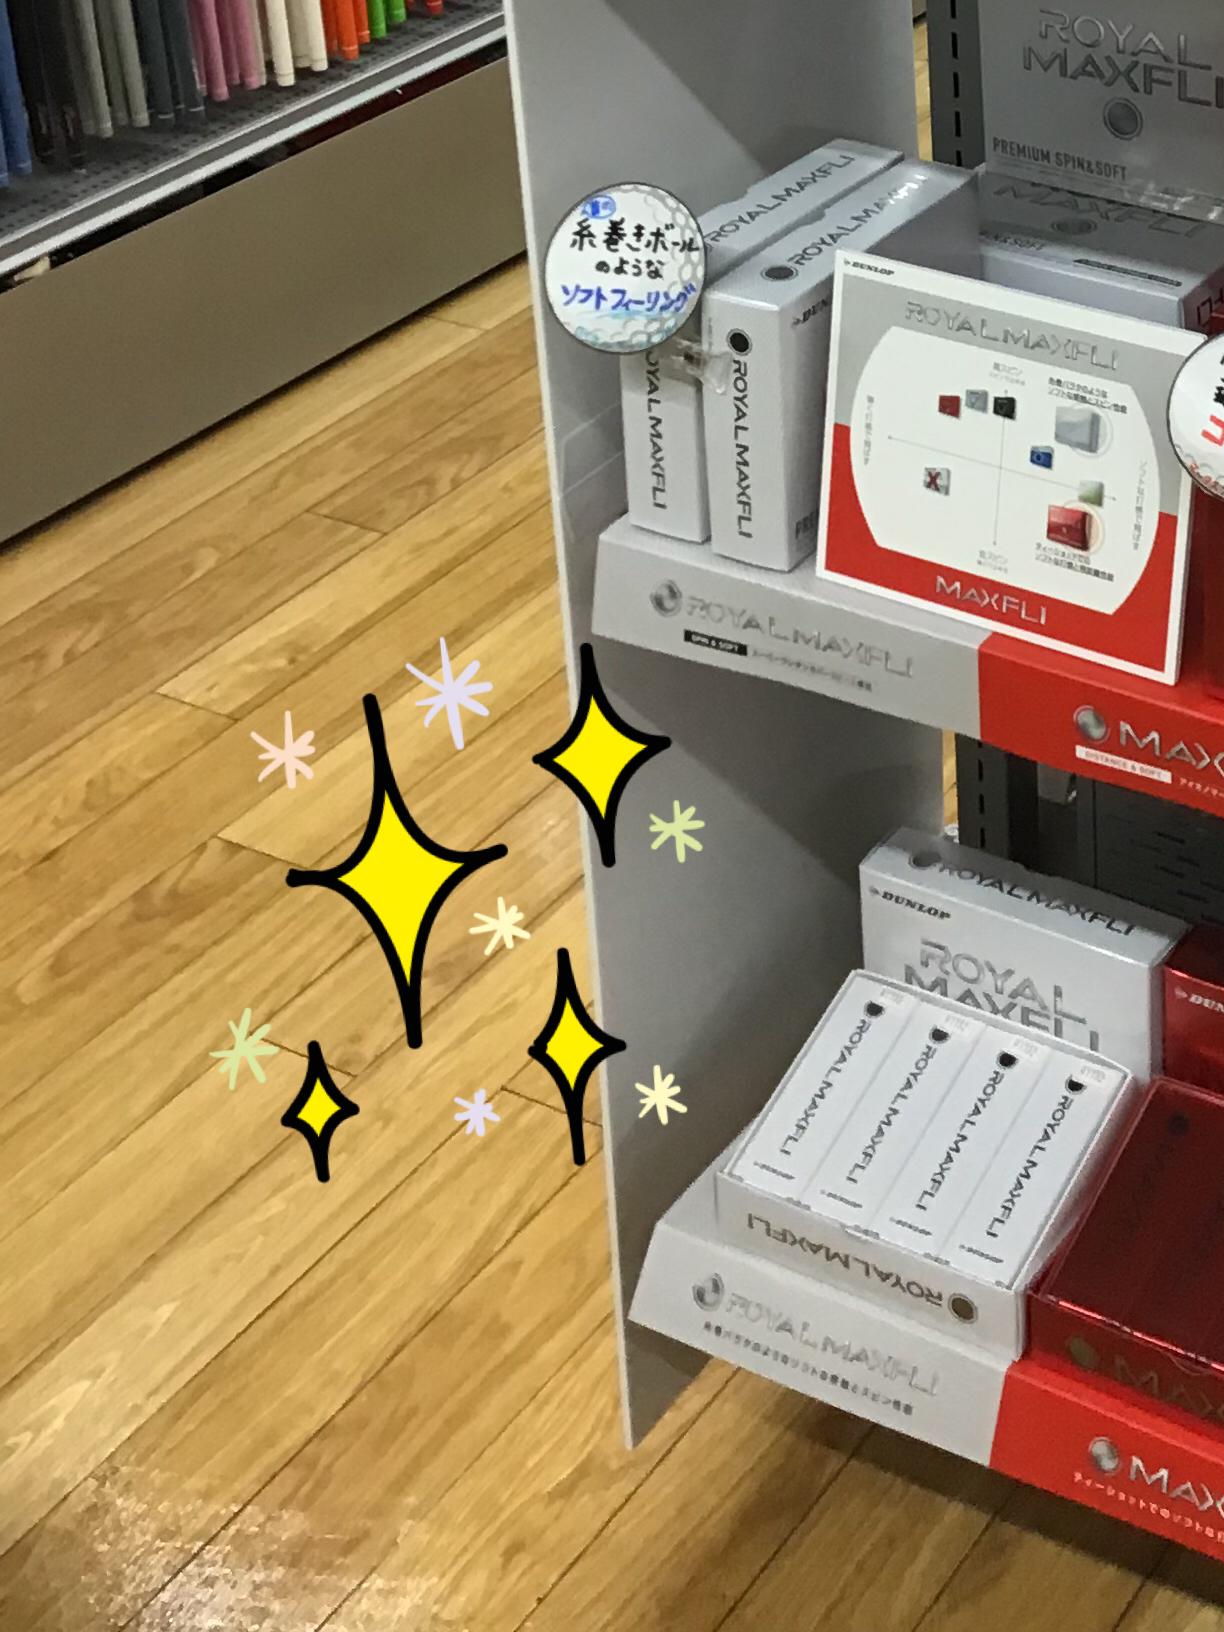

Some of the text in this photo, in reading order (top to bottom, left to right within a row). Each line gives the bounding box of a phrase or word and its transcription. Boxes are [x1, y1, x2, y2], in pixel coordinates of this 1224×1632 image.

[1039, 8, 1212, 71] ROYAL
[1023, 46, 1224, 110] MAXFLI
[993, 137, 1051, 167] PREMIUM
[570, 218, 700, 254] 糸巻きボール
[595, 258, 664, 280] のような
[561, 282, 696, 313] ソフトフィーリング
[935, 576, 1047, 626] MAXFLI
[880, 890, 951, 921] DUNLOP
[920, 938, 1087, 1025] ROYAL
